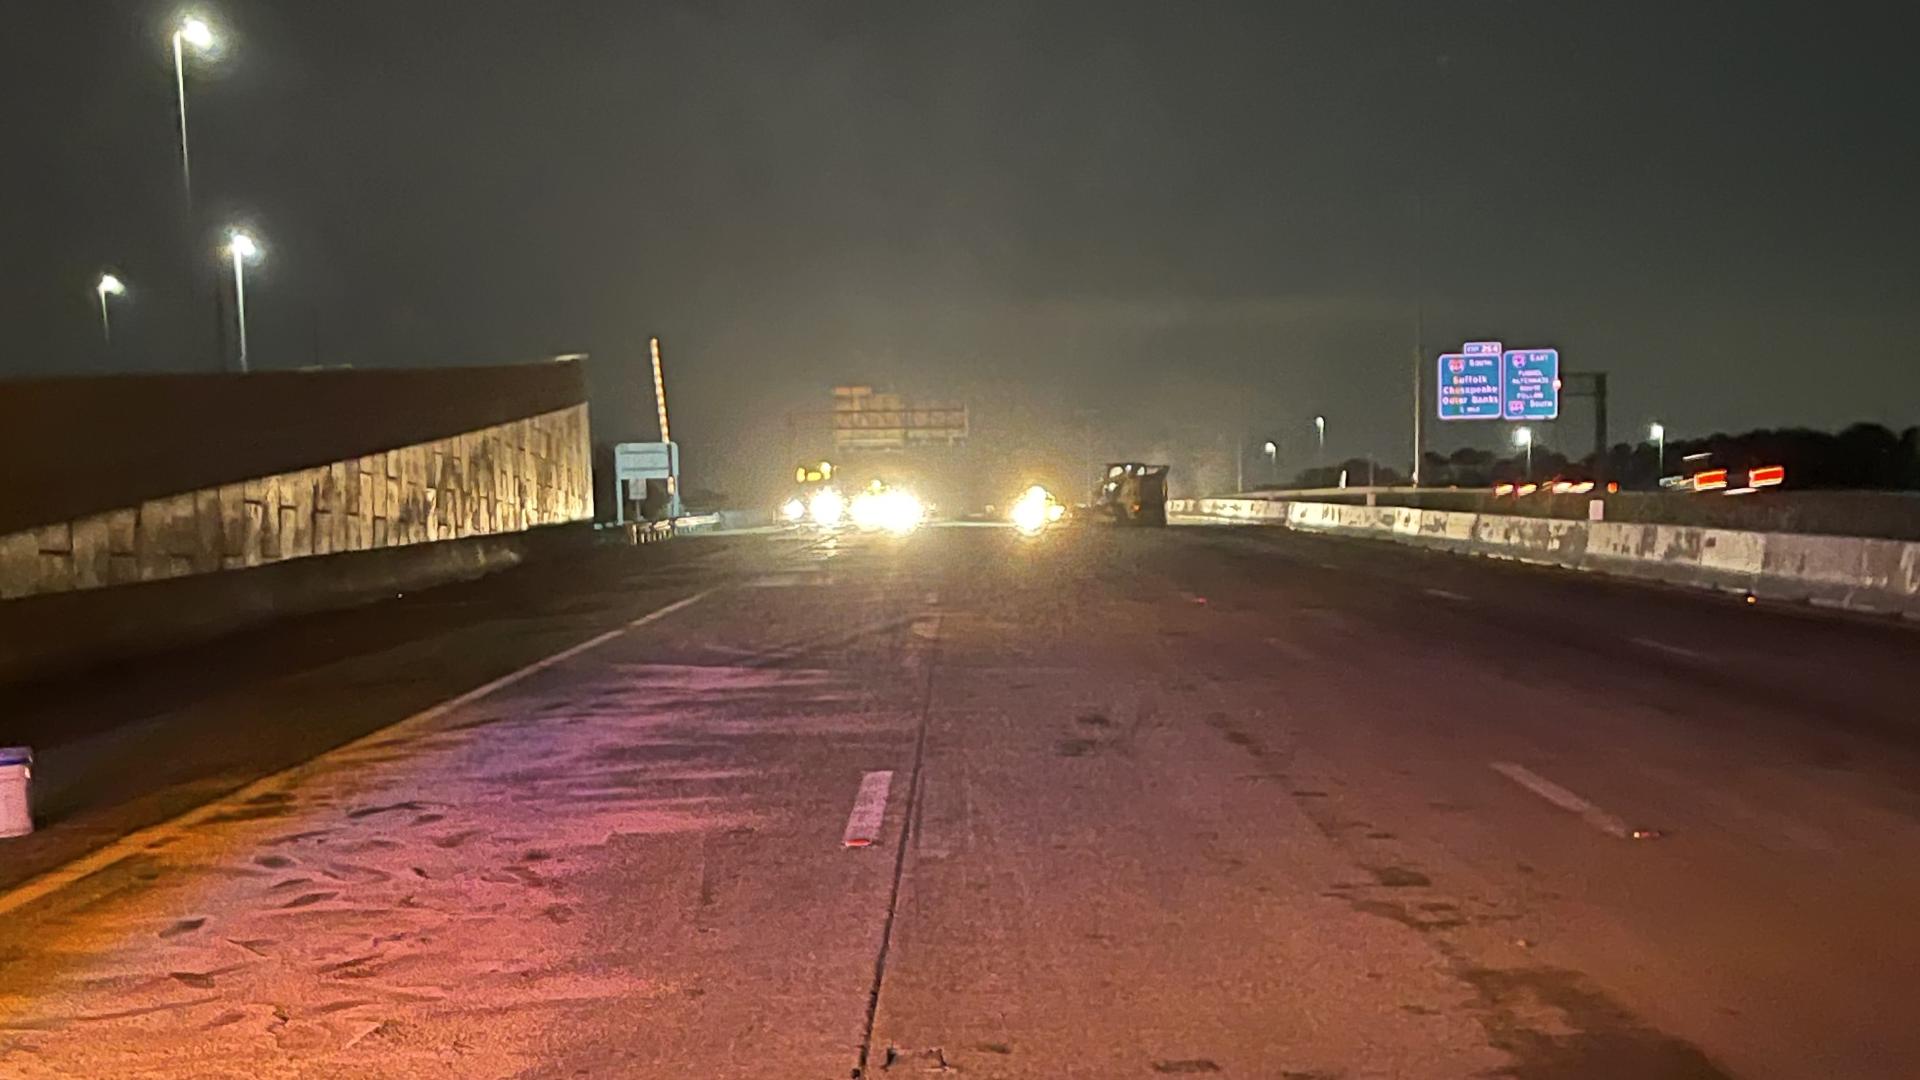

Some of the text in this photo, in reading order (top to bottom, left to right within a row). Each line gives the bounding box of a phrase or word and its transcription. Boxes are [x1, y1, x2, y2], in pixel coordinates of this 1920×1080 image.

[1453, 375, 1488, 384] Suffolk
[1443, 385, 1497, 395] Chesapeake
[1442, 395, 1498, 405] Outer Banks
